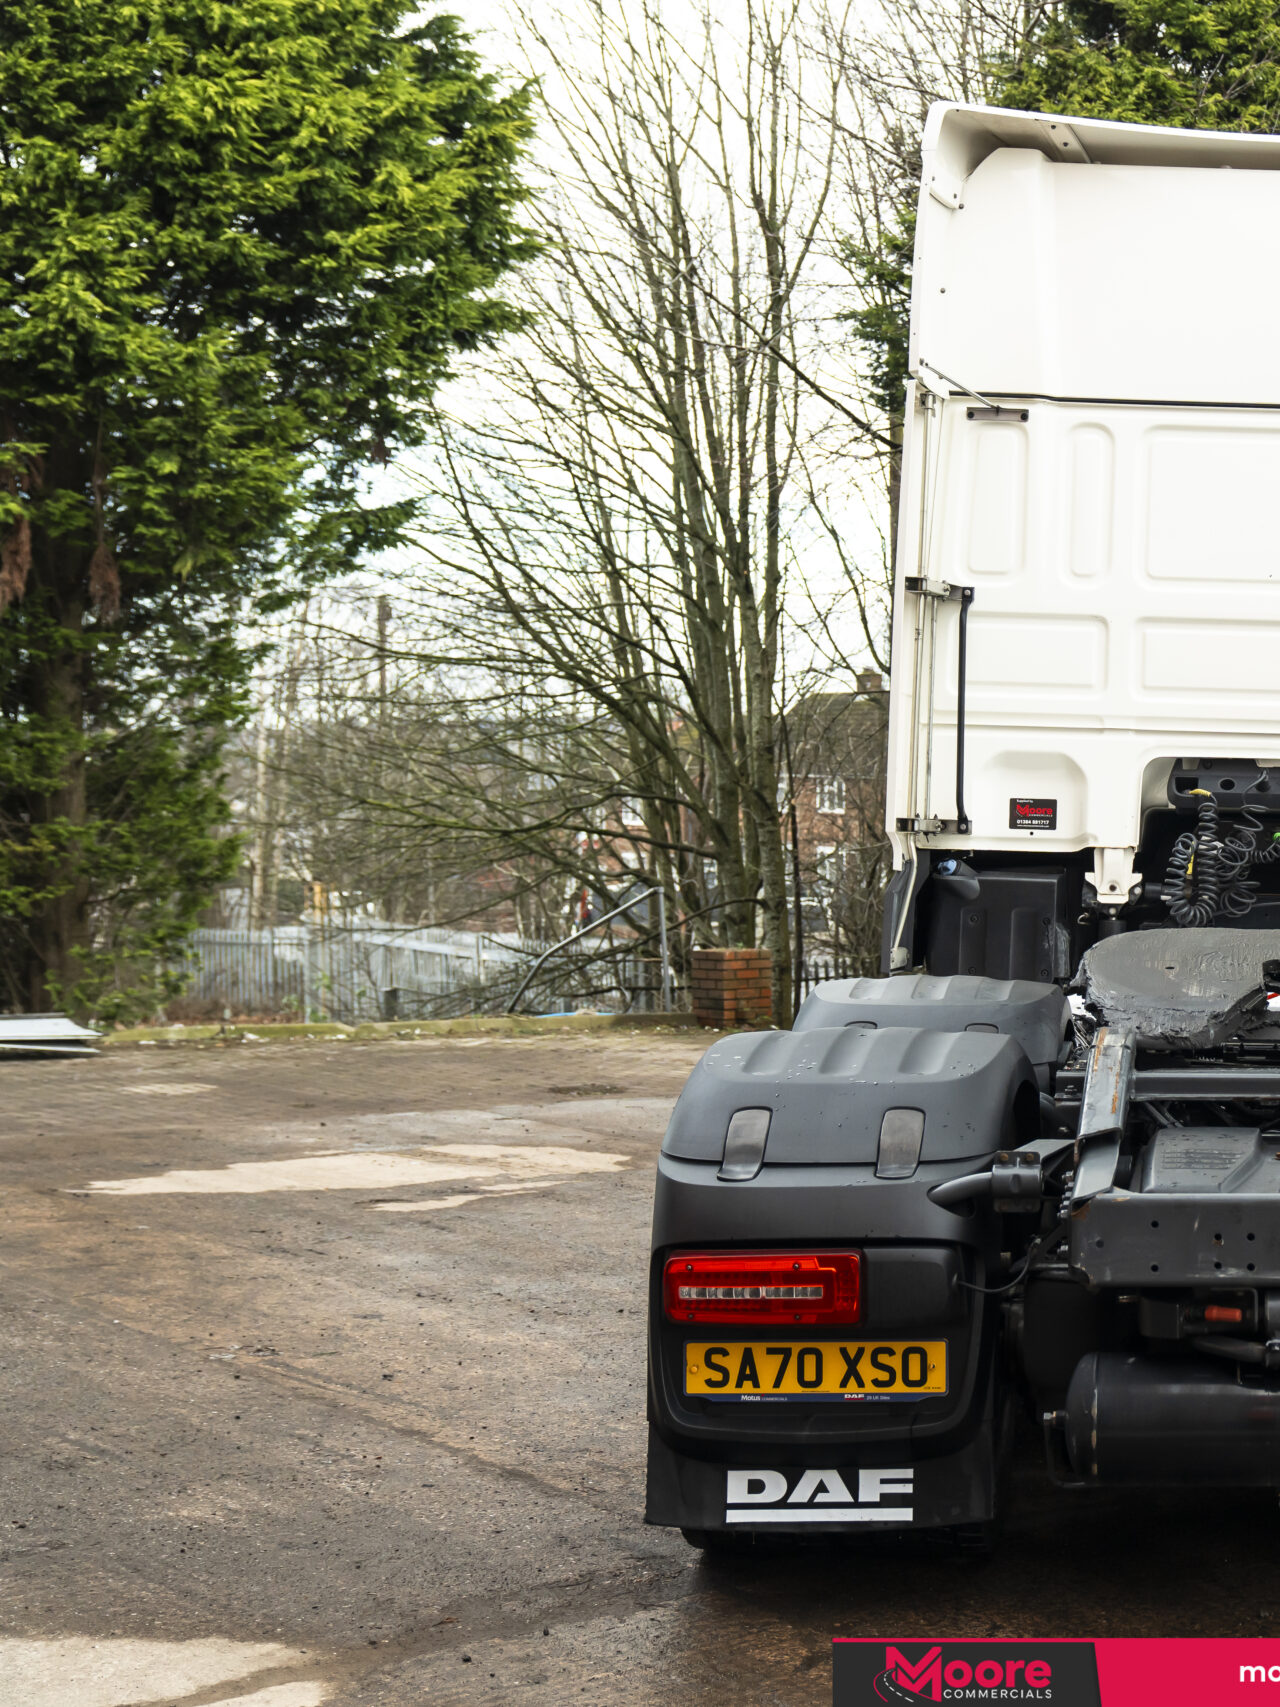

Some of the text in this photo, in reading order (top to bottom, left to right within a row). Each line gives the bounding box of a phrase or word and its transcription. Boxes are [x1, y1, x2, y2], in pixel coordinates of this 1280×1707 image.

[1016, 804, 1053, 817] Moore
[704, 1346, 928, 1389] SA70 XSO
[726, 1468, 914, 1503] DAF
